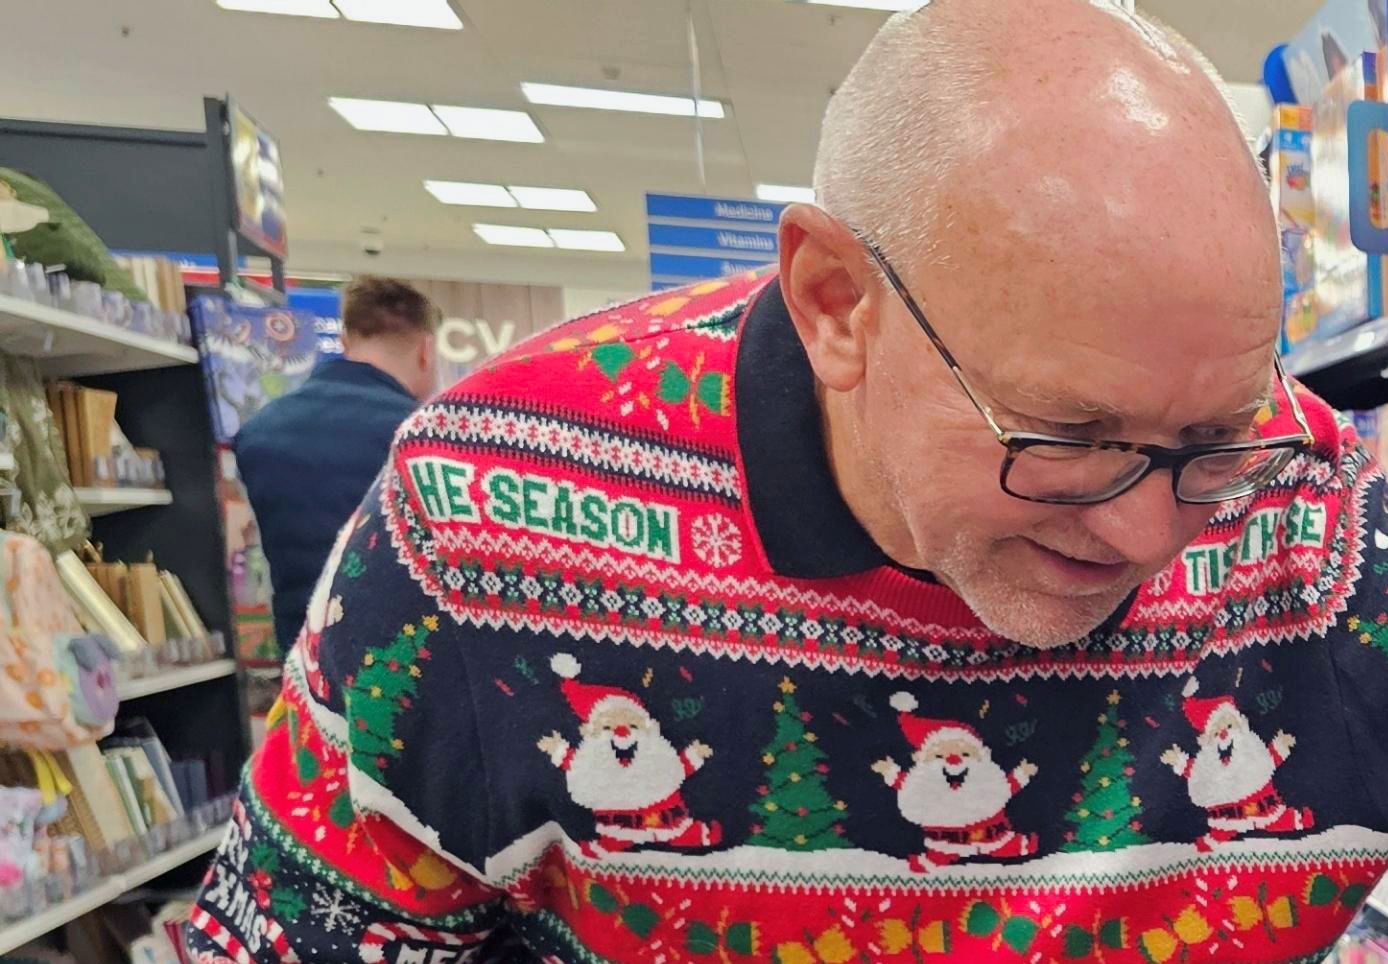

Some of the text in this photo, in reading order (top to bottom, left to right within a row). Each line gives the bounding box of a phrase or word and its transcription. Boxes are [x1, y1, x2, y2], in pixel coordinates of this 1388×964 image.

[715, 201, 774, 221] Medicine
[717, 231, 775, 250] Vitamins
[411, 460, 675, 558] HE SEASON
[205, 863, 269, 953] XMAS
